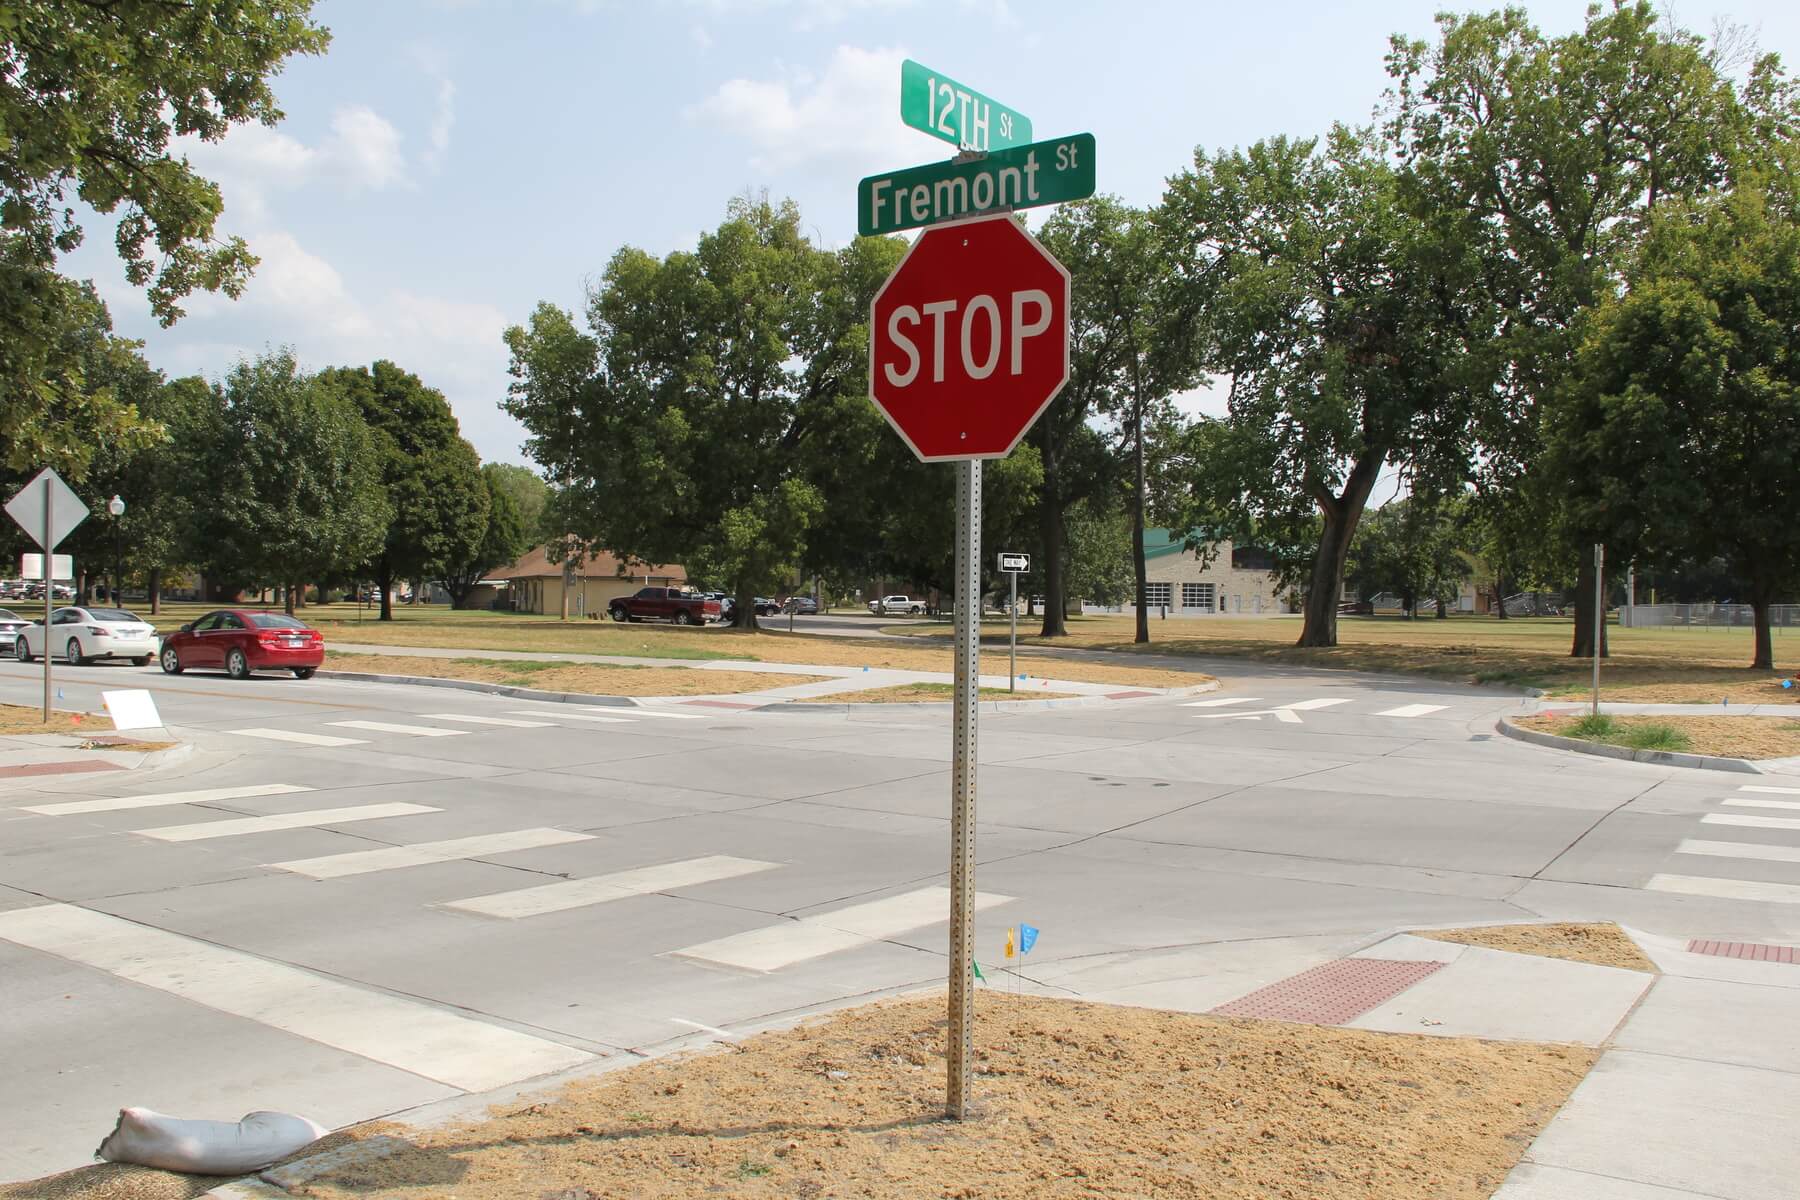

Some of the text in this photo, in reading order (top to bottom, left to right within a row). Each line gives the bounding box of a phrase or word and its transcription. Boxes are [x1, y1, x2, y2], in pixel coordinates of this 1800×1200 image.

[927, 77, 1013, 152] 12TH St
[871, 141, 1079, 230] Fremont St
[883, 288, 1053, 388] STOP
